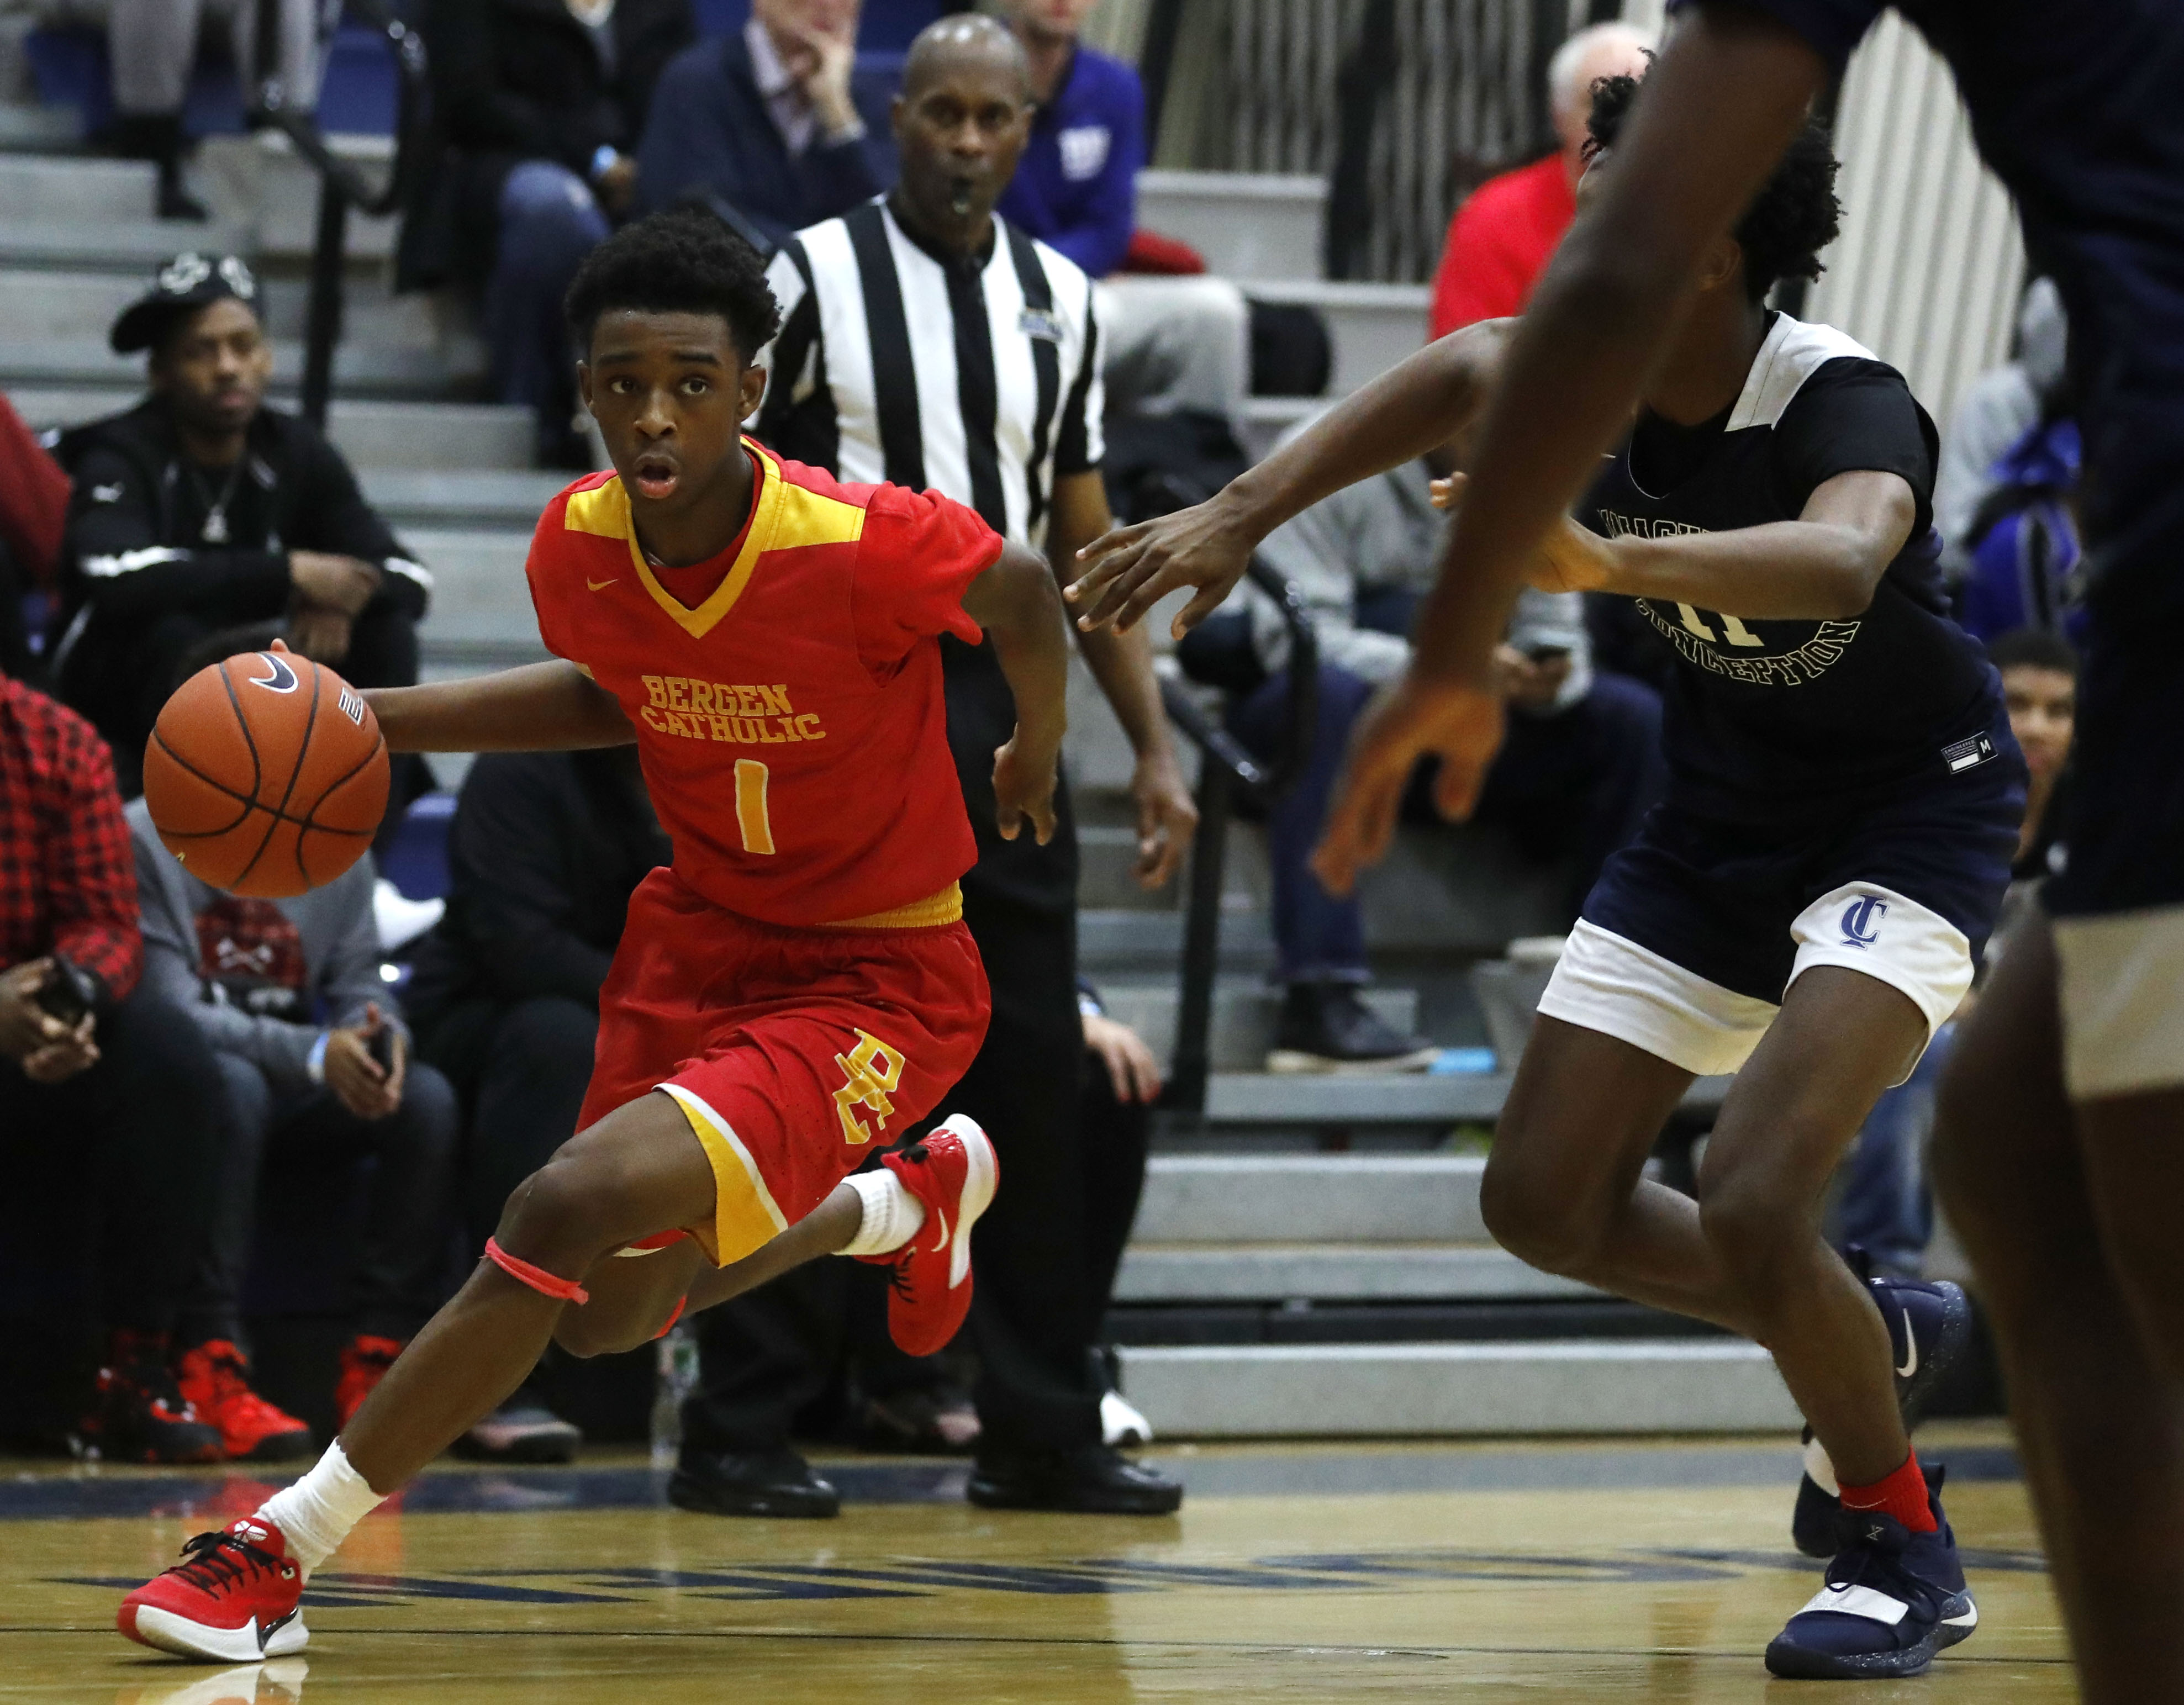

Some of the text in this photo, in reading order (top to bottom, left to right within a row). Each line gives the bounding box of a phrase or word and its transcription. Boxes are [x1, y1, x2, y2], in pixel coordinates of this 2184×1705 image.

[1636, 598, 1861, 685] CONCEPTION
[641, 675, 793, 716] BERGEN
[641, 705, 826, 743] CATHOLIC
[1980, 739, 1991, 753] M
[734, 758, 776, 855] 1
